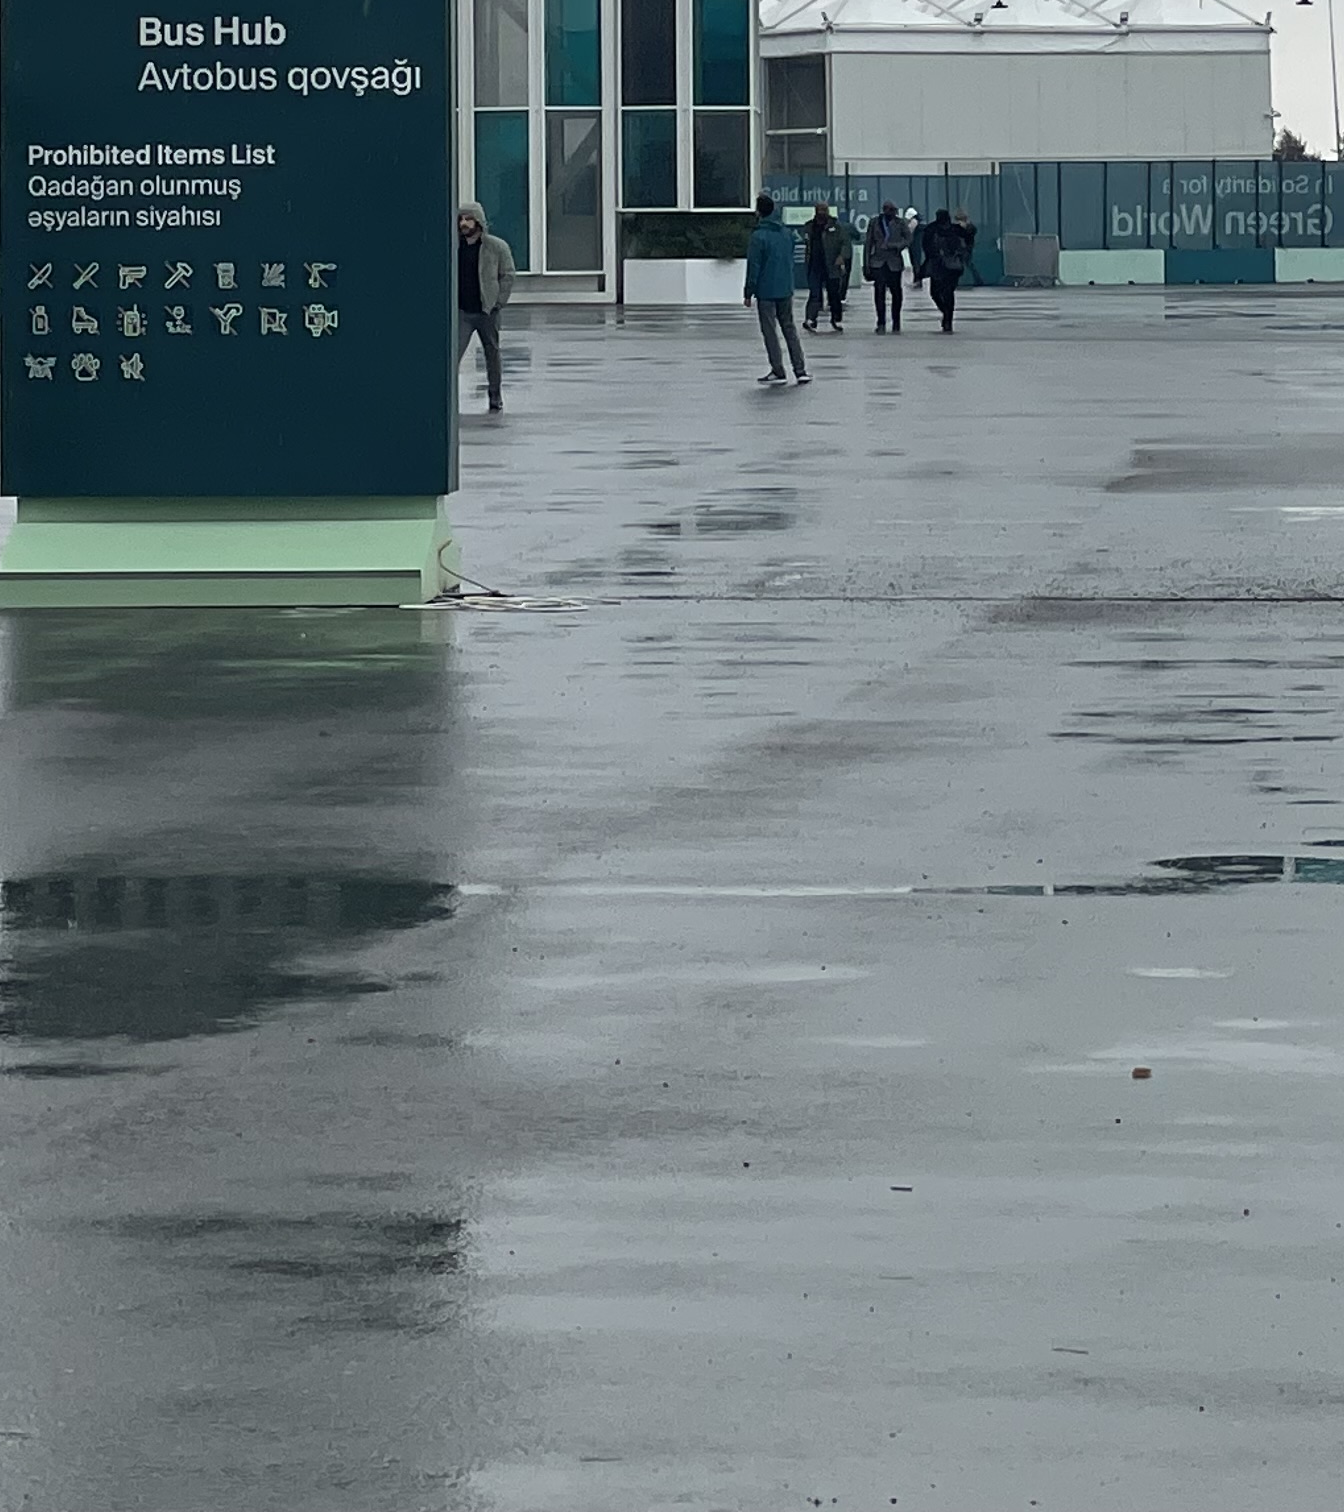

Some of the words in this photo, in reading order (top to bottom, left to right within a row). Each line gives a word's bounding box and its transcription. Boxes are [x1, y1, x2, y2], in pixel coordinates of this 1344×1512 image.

[138, 17, 205, 46] Bus
[214, 16, 287, 46] Hub
[137, 61, 278, 91] Avtobus
[287, 58, 422, 96] qovşağı
[27, 144, 151, 166] Prohibited
[157, 144, 225, 165] Items
[231, 144, 276, 165] List
[27, 175, 134, 201] Qadağan
[140, 175, 242, 200] olunmuş
[761, 187, 830, 204] Solidrity
[27, 206, 130, 232] əşyaların
[135, 206, 222, 230] siyahısı
